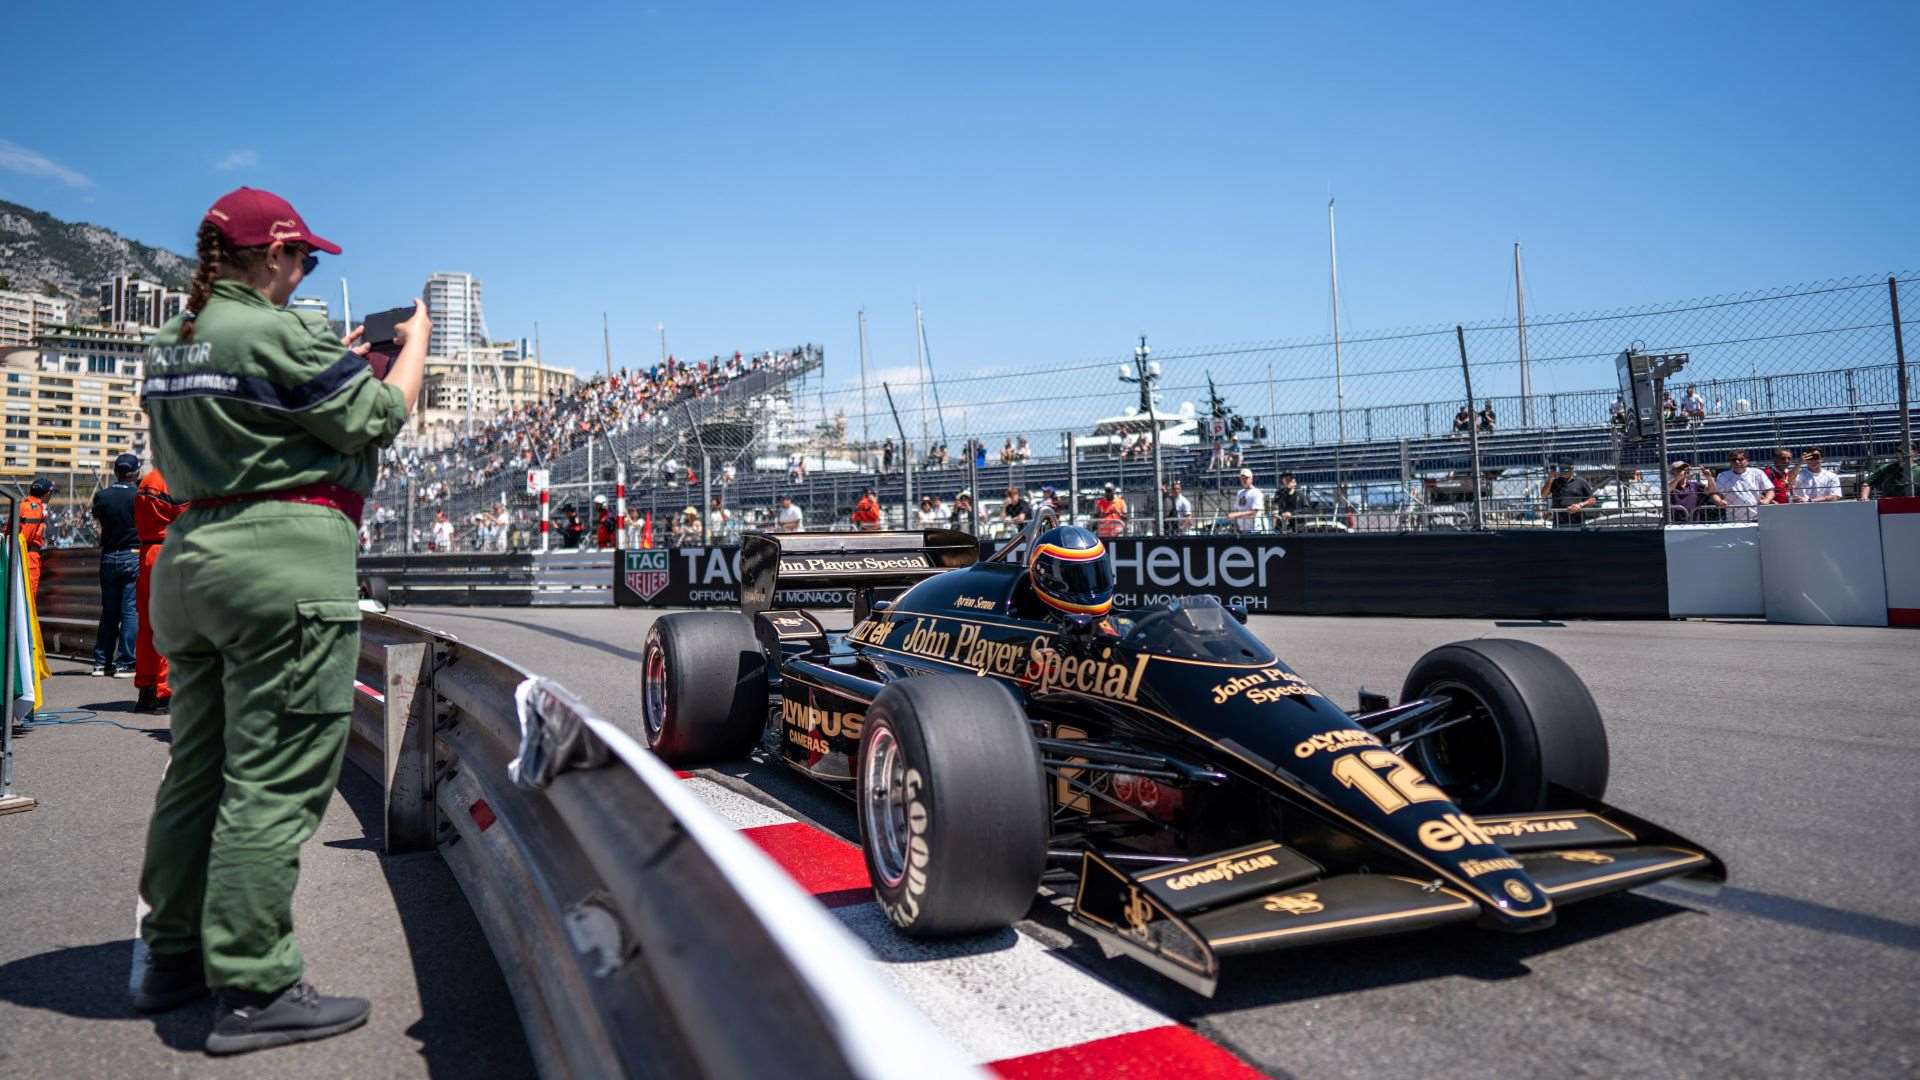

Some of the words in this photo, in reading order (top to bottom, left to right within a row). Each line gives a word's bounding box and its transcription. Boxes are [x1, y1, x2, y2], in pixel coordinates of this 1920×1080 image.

[628, 553, 665, 569] TAG
[780, 560, 806, 572] hn
[806, 559, 863, 572] Player
[863, 557, 929, 571] Special
[1109, 541, 1287, 588] Heuer
[627, 572, 666, 597] HEUER
[689, 590, 739, 602] OFFICIAL
[786, 592, 842, 604] MONACO
[902, 617, 950, 659] John
[950, 623, 1024, 678] Player
[1025, 634, 1151, 702] Special
[1211, 672, 1265, 705] John
[789, 728, 830, 755] CAMERAS
[1332, 748, 1451, 816] 12
[1165, 855, 1279, 891] GOODYEAR
